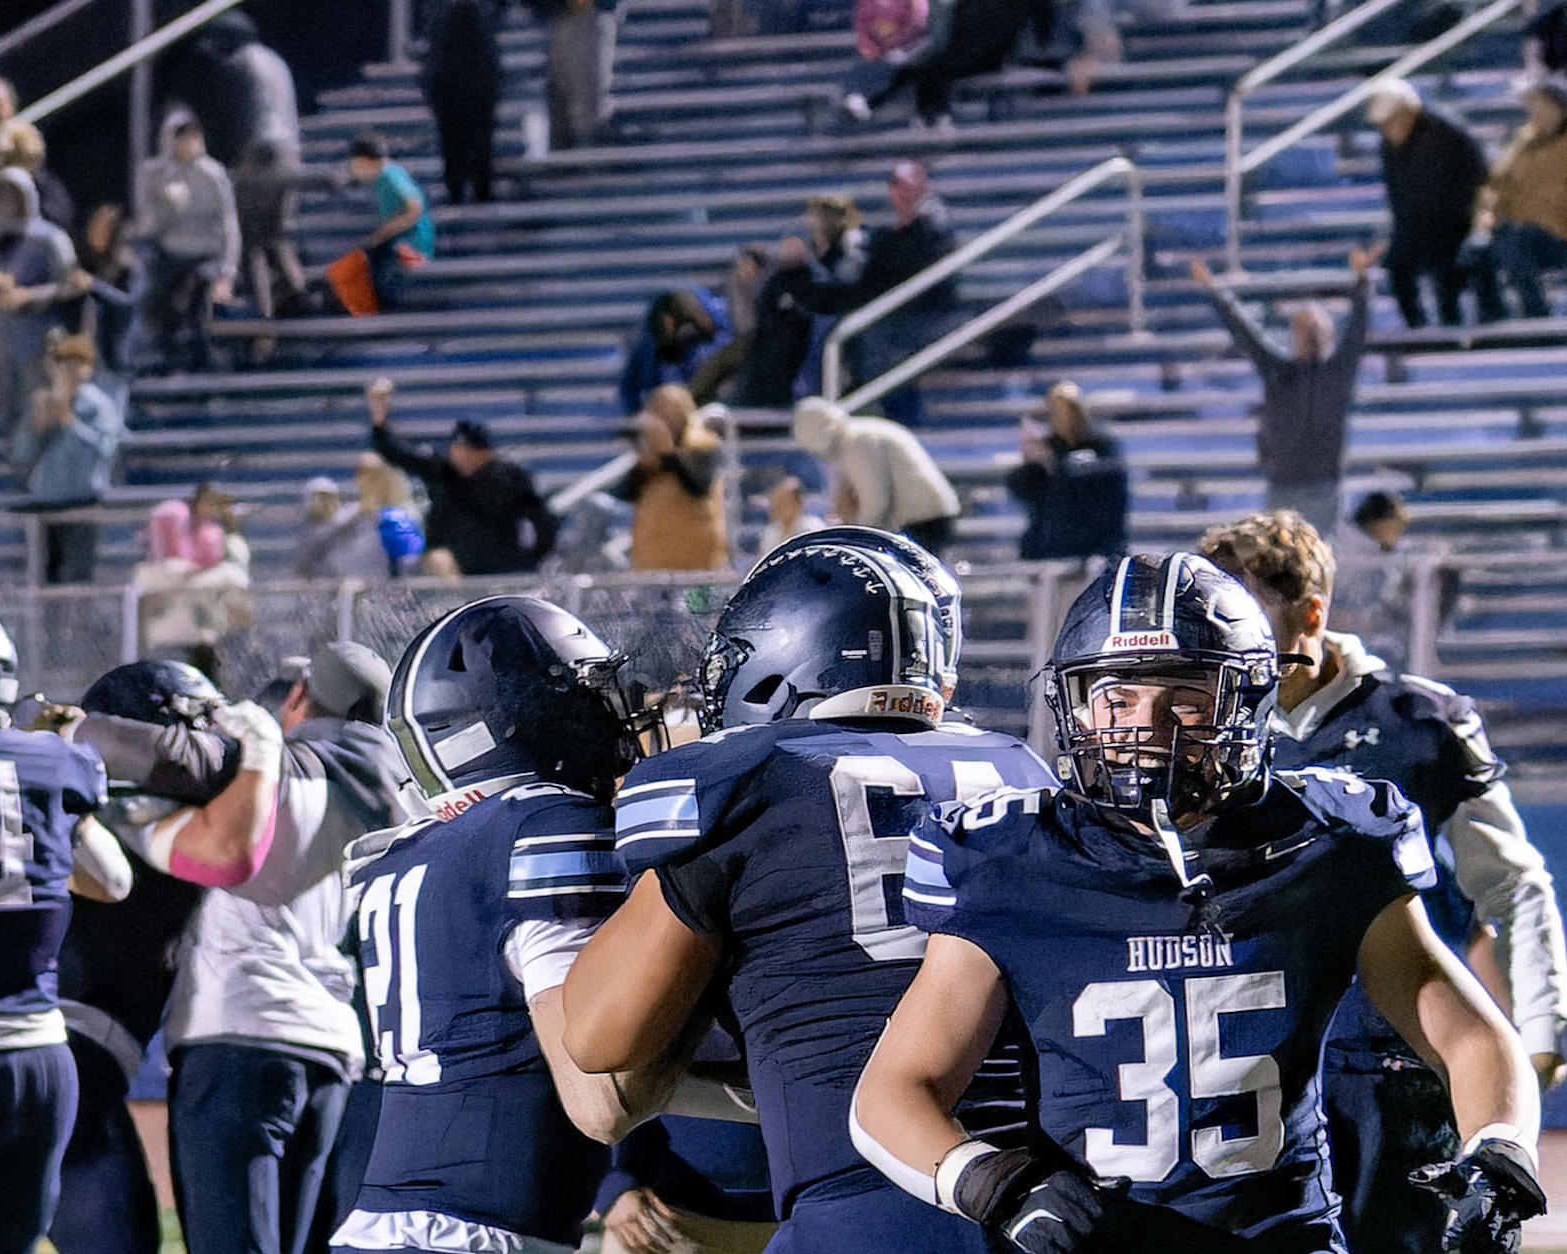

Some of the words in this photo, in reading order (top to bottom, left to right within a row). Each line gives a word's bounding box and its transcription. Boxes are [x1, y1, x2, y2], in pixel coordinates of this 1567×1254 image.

[1112, 634, 1169, 648] Riddell
[1127, 932, 1235, 972] HUDSON
[1073, 971, 1287, 1184] 35
